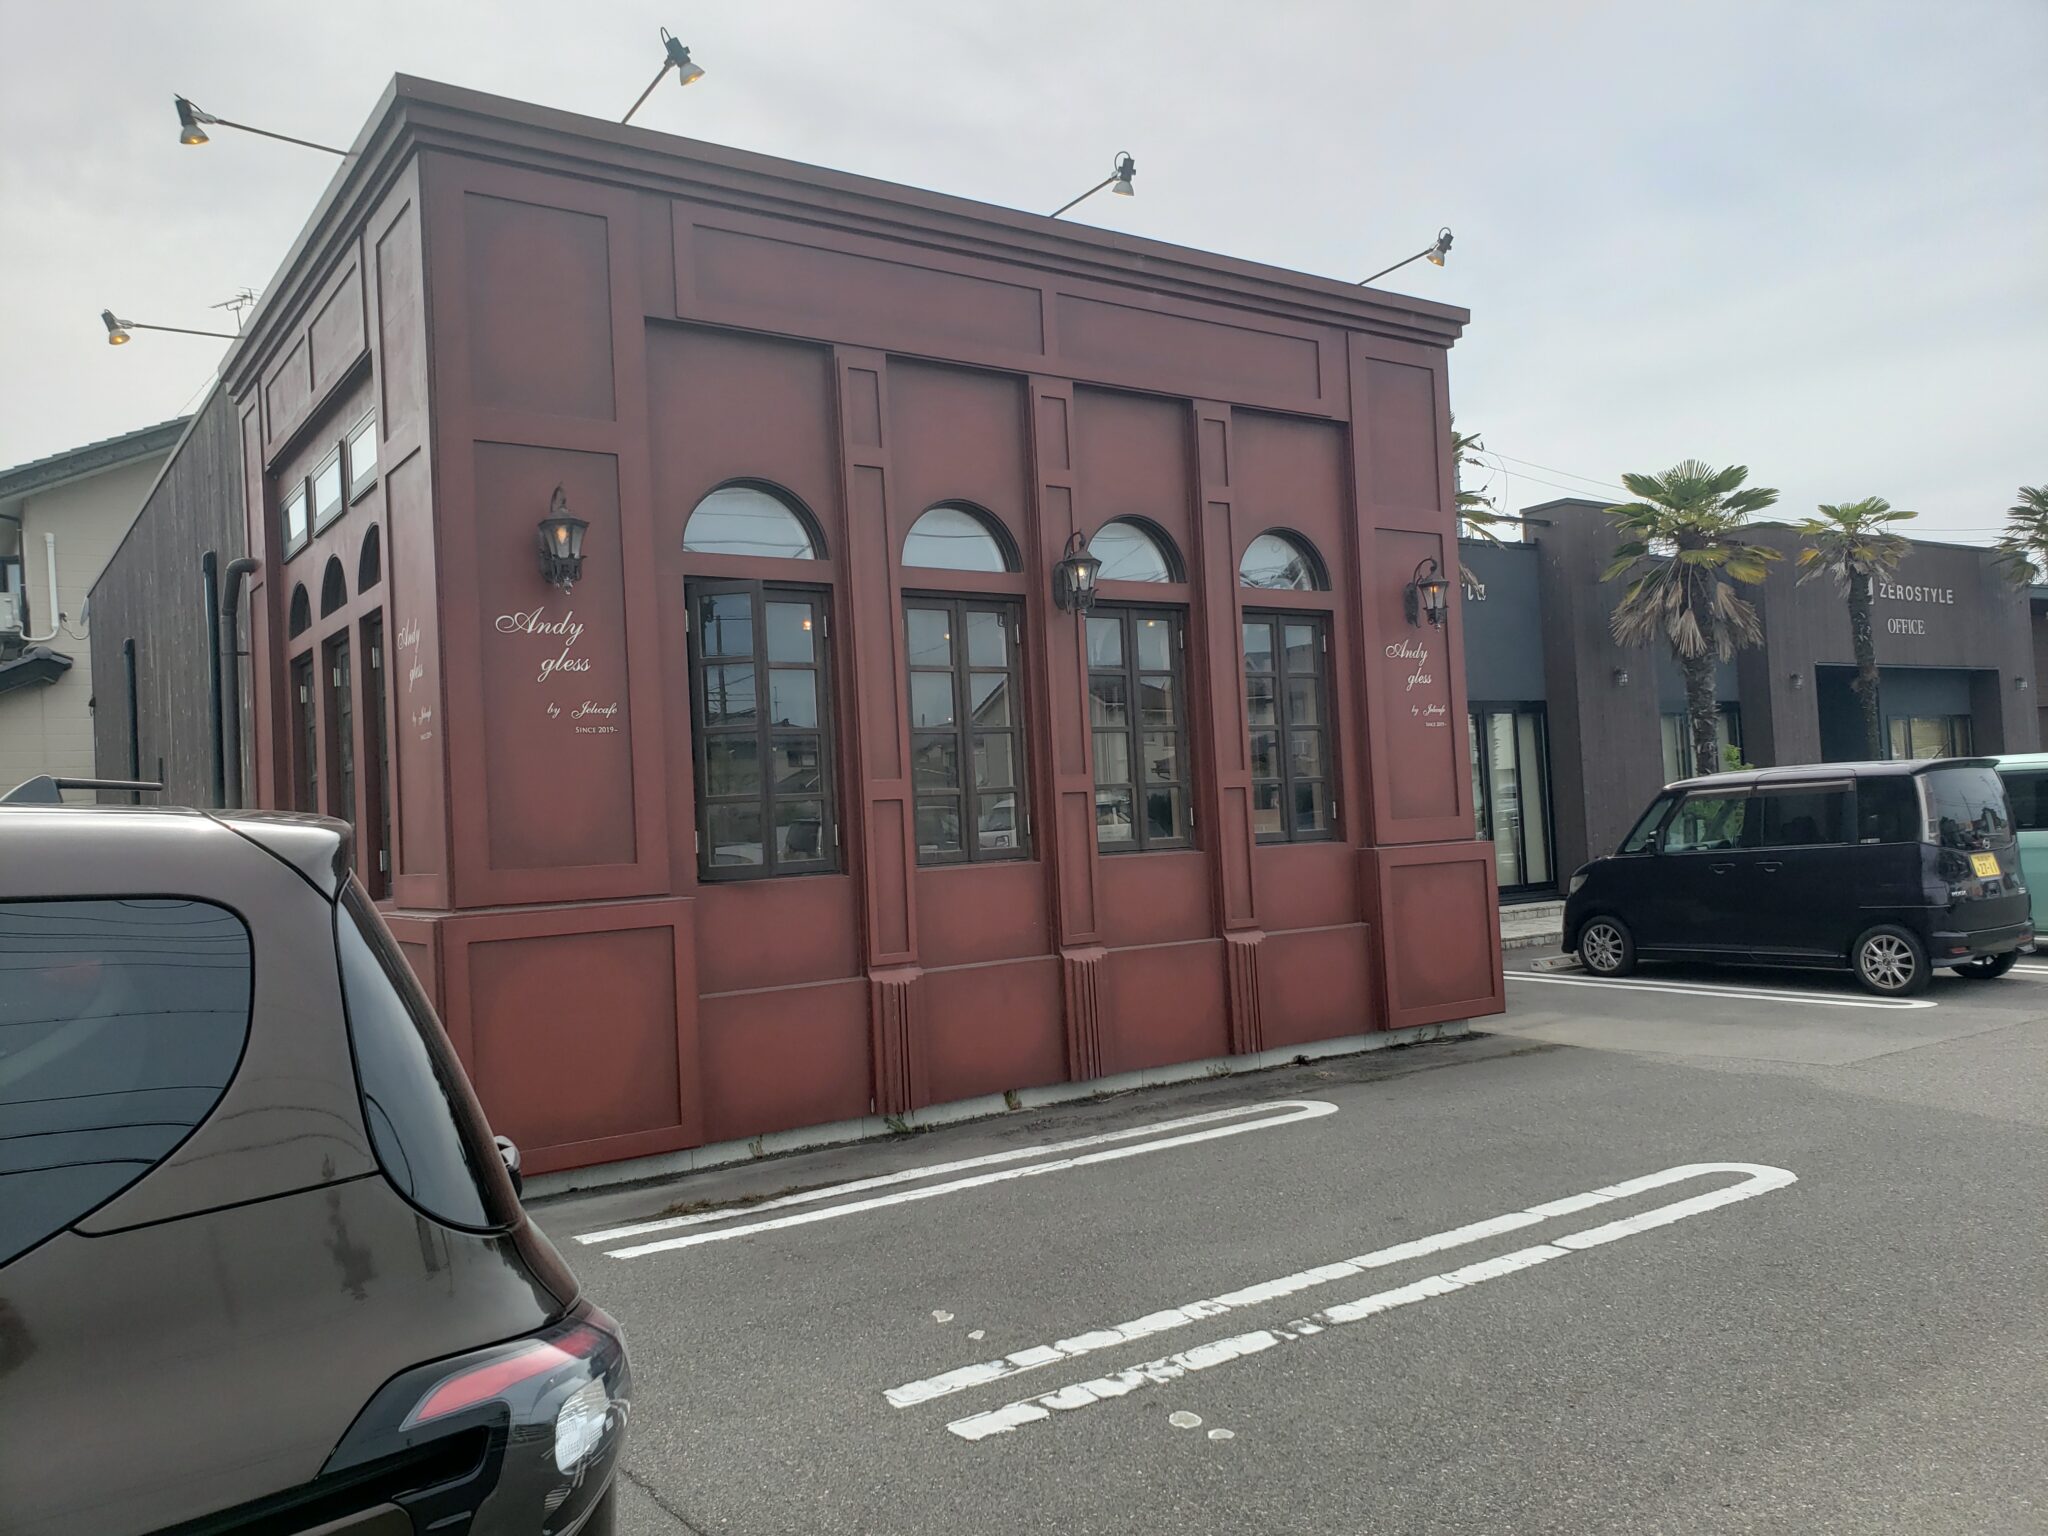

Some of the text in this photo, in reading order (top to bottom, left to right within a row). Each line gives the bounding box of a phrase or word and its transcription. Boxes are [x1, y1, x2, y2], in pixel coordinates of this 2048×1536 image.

[1879, 583, 1954, 604] ZEROSTYLE
[495, 606, 585, 646] Andy
[1887, 618, 1926, 635] OFFICE
[1385, 639, 1428, 666] Andy
[537, 648, 591, 683] gless
[1406, 667, 1432, 691] gless
[547, 702, 560, 719] by
[575, 726, 596, 734] SINCE
